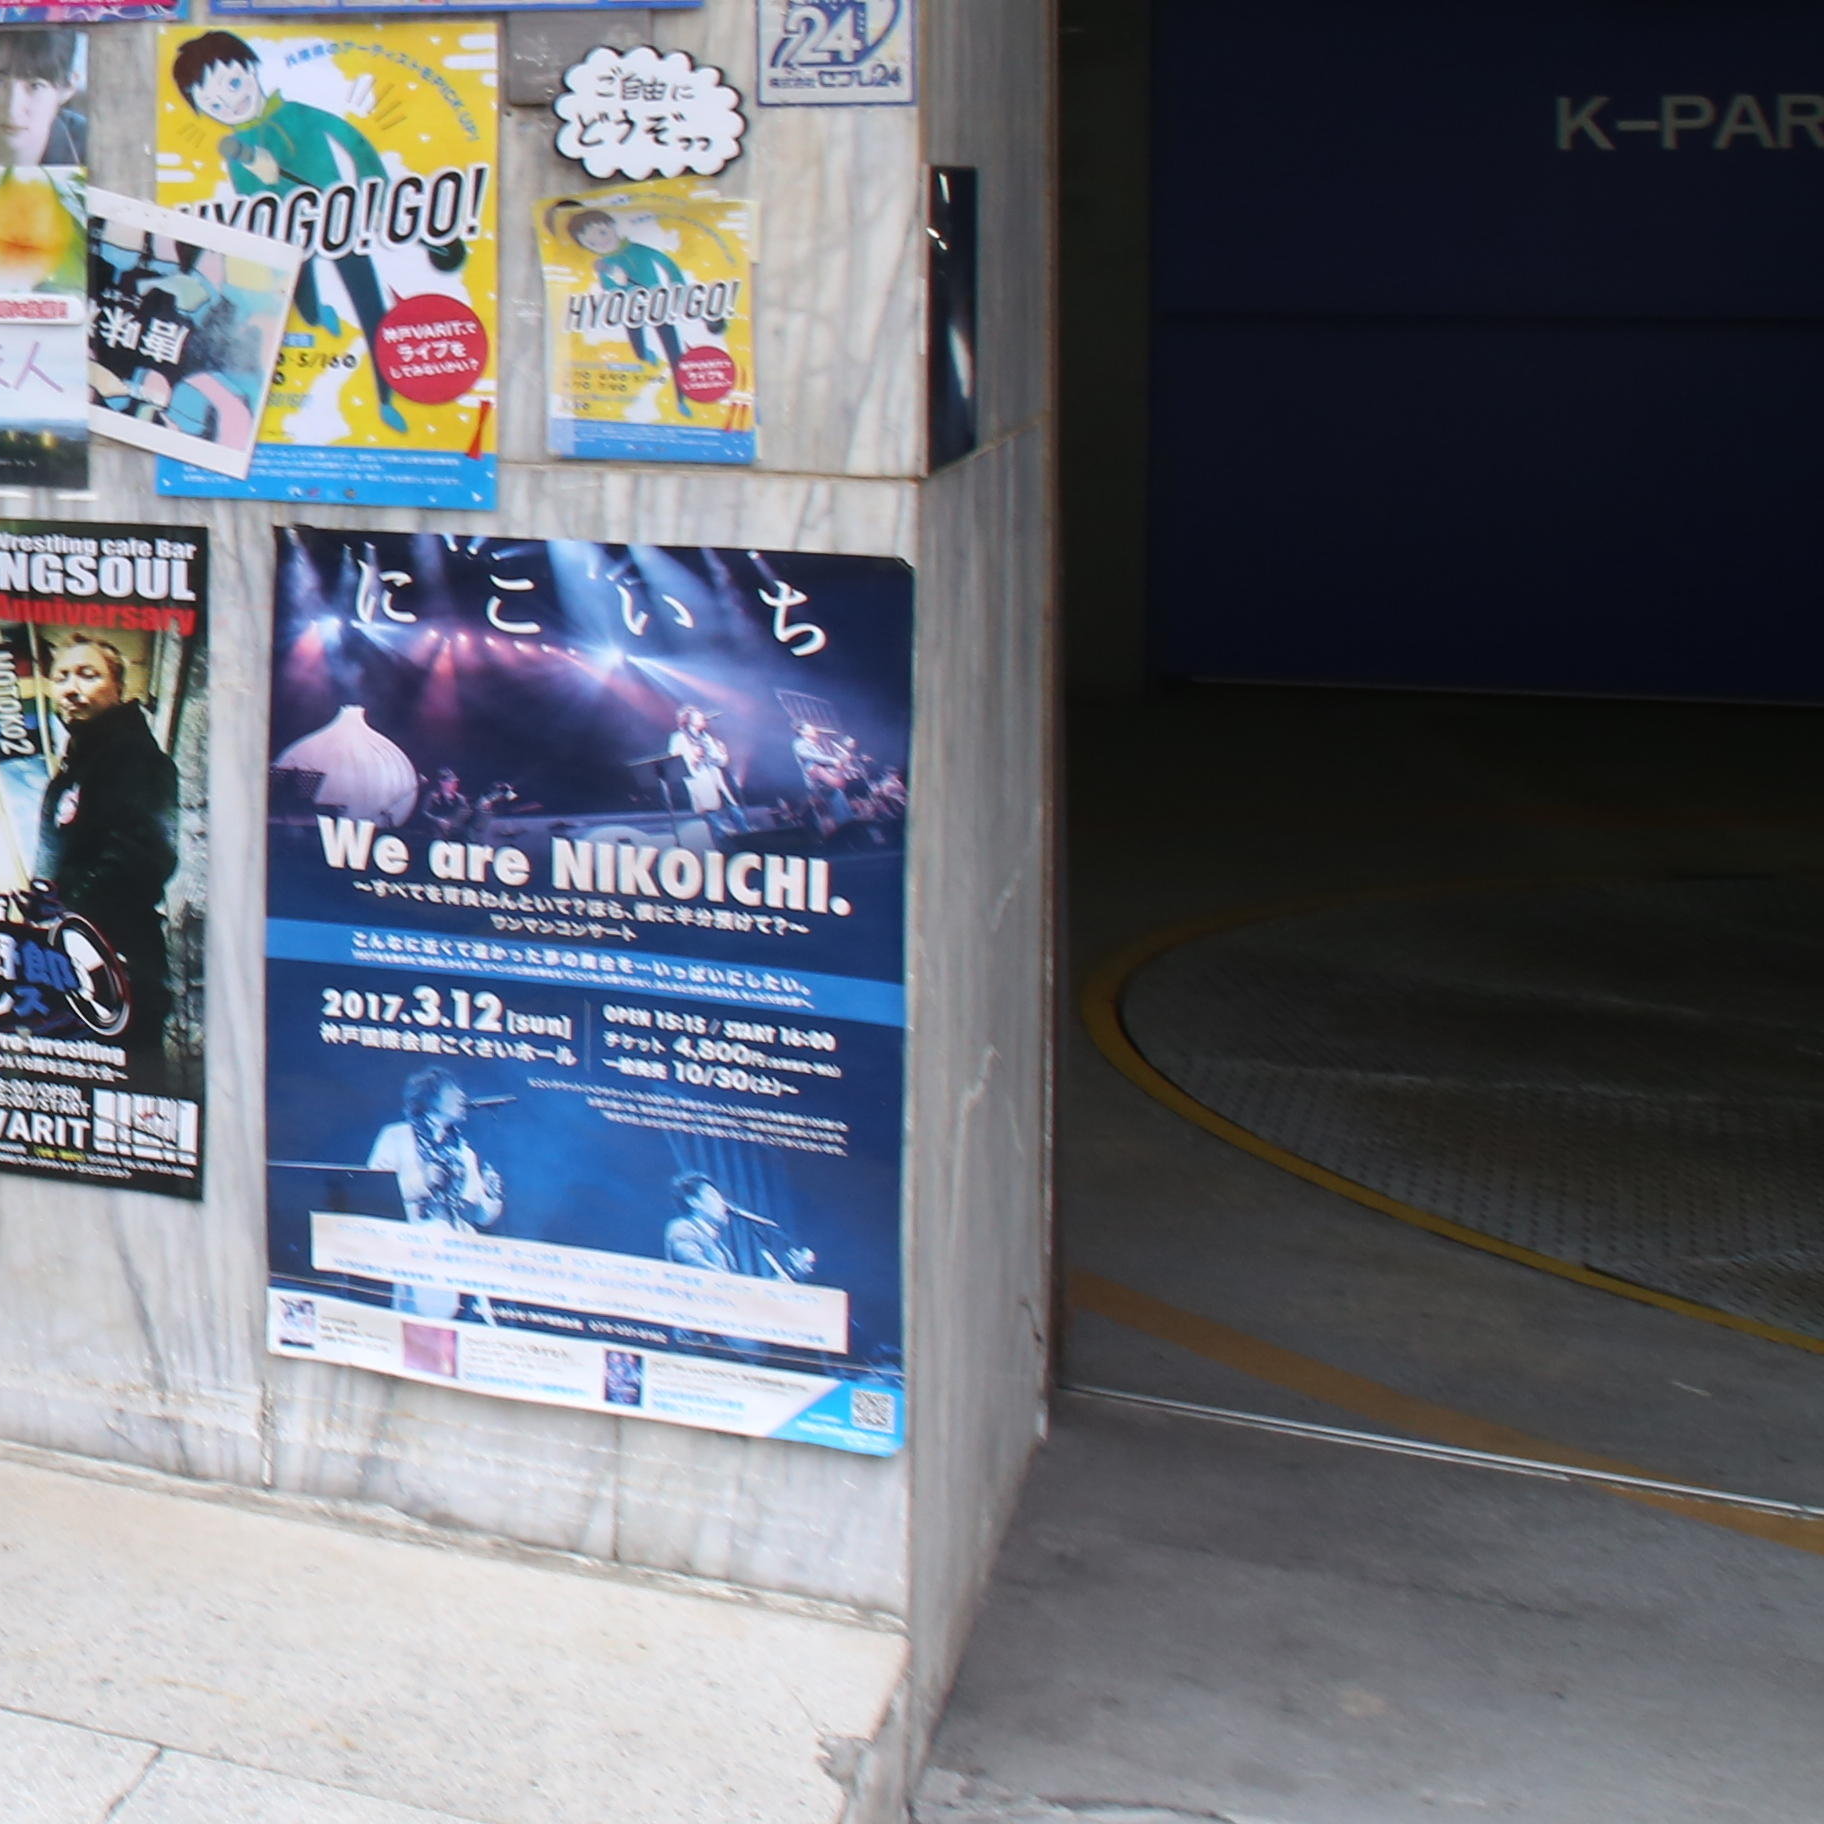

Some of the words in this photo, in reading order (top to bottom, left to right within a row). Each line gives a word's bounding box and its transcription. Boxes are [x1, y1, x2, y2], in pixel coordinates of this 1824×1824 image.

[783, 4, 865, 66] 24
[594, 71, 696, 103] ご自由に
[178, 164, 489, 257] YOGO!GO!
[396, 341, 468, 362] ライブを
[104, 536, 150, 559] cafe
[156, 538, 197, 561] Bar
[357, 559, 828, 658] にこいち
[316, 815, 411, 876] We
[428, 833, 531, 887] are
[551, 837, 854, 918] NIKOICHI.
[489, 912, 639, 942] ワンマンコンサート
[320, 984, 504, 1034] 2017.3.12
[602, 1003, 649, 1027] OPEN
[654, 1009, 706, 1034] 15:15
[779, 1024, 837, 1053] 16:00
[320, 1020, 578, 1067] 神戸国際会館こくさいホール
[603, 1028, 667, 1055] チケット
